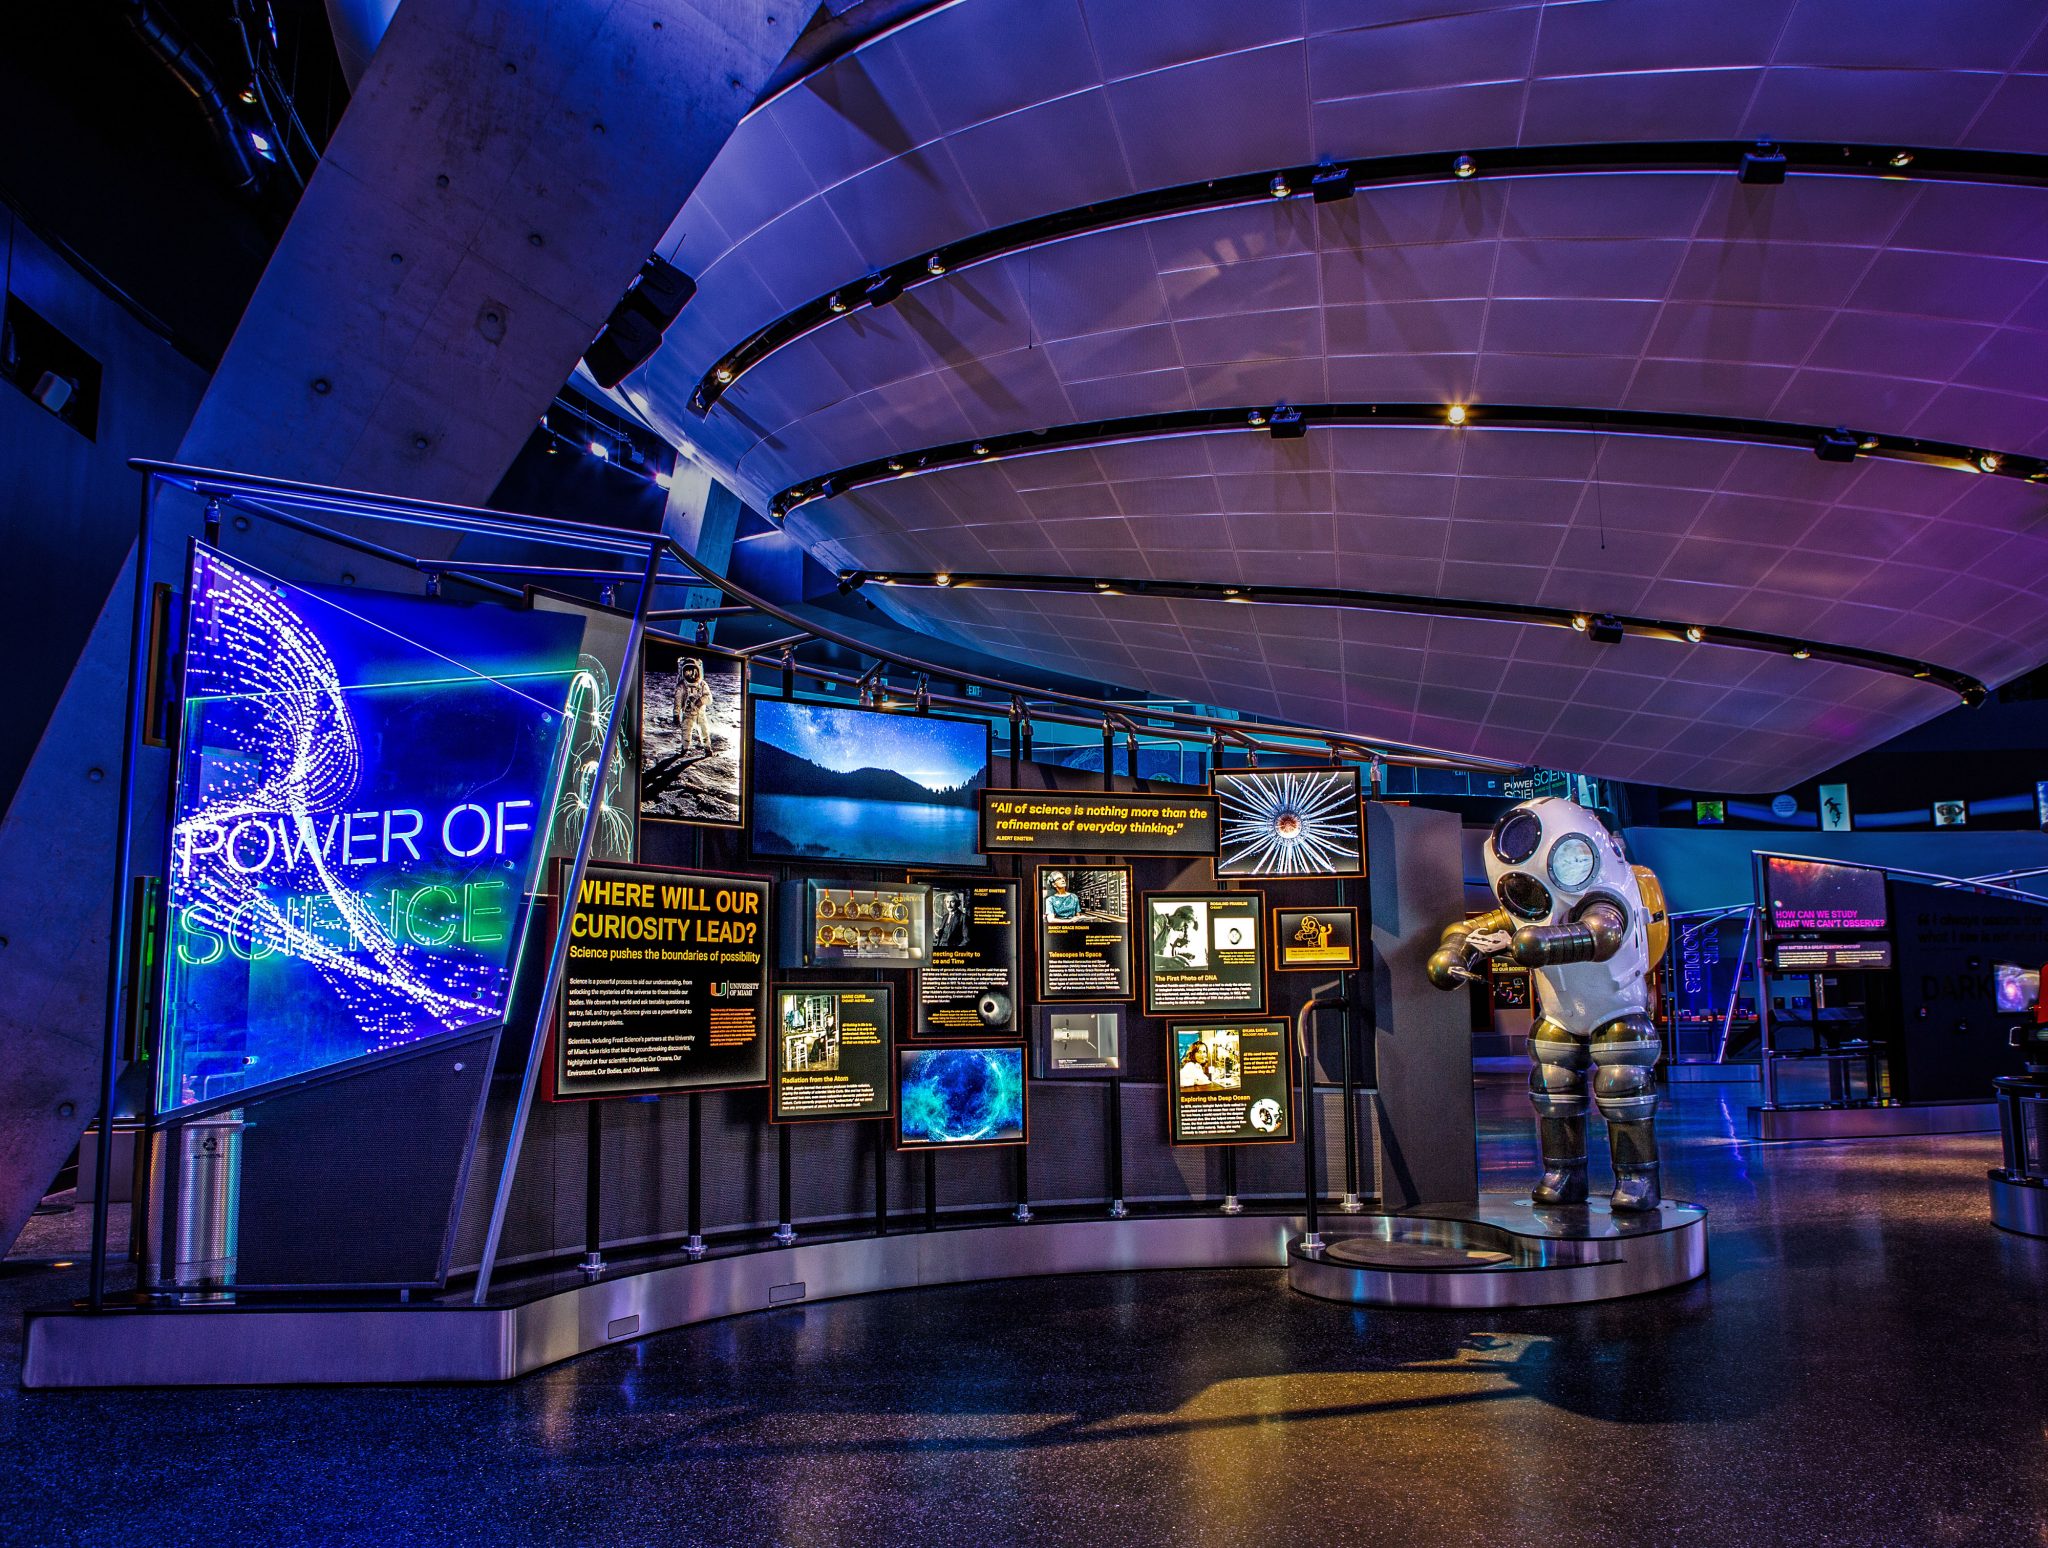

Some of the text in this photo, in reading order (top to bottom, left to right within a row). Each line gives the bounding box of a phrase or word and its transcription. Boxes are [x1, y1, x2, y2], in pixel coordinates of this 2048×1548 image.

[969, 685, 980, 696] EXIT
[1014, 803, 1027, 814] of
[1029, 803, 1072, 815] science
[1074, 804, 1084, 816] is
[1086, 805, 1128, 818] nothing
[1131, 808, 1159, 818] more
[1161, 806, 1187, 818] than
[1189, 807, 1208, 819] the
[996, 819, 1059, 831] refinement
[1061, 820, 1074, 831] of
[1076, 821, 1127, 835] everyday
[183, 800, 531, 878] POWER OF
[577, 880, 759, 914] WHERE WILL OUR
[178, 881, 504, 965] SCIENCE
[1775, 910, 1858, 919] HOW CAN WE STUDY
[1776, 920, 1800, 928] WHAT
[1801, 920, 1815, 928] WE
[1843, 919, 1885, 927] OBSERVE?
[571, 912, 757, 944] CURIOSITY LEAD?
[1703, 924, 1719, 964] OUR
[570, 945, 760, 964] Science pushes the boundaries of possibility
[1683, 924, 1701, 993] BODIES
[730, 982, 759, 990] UNIVERSITY
